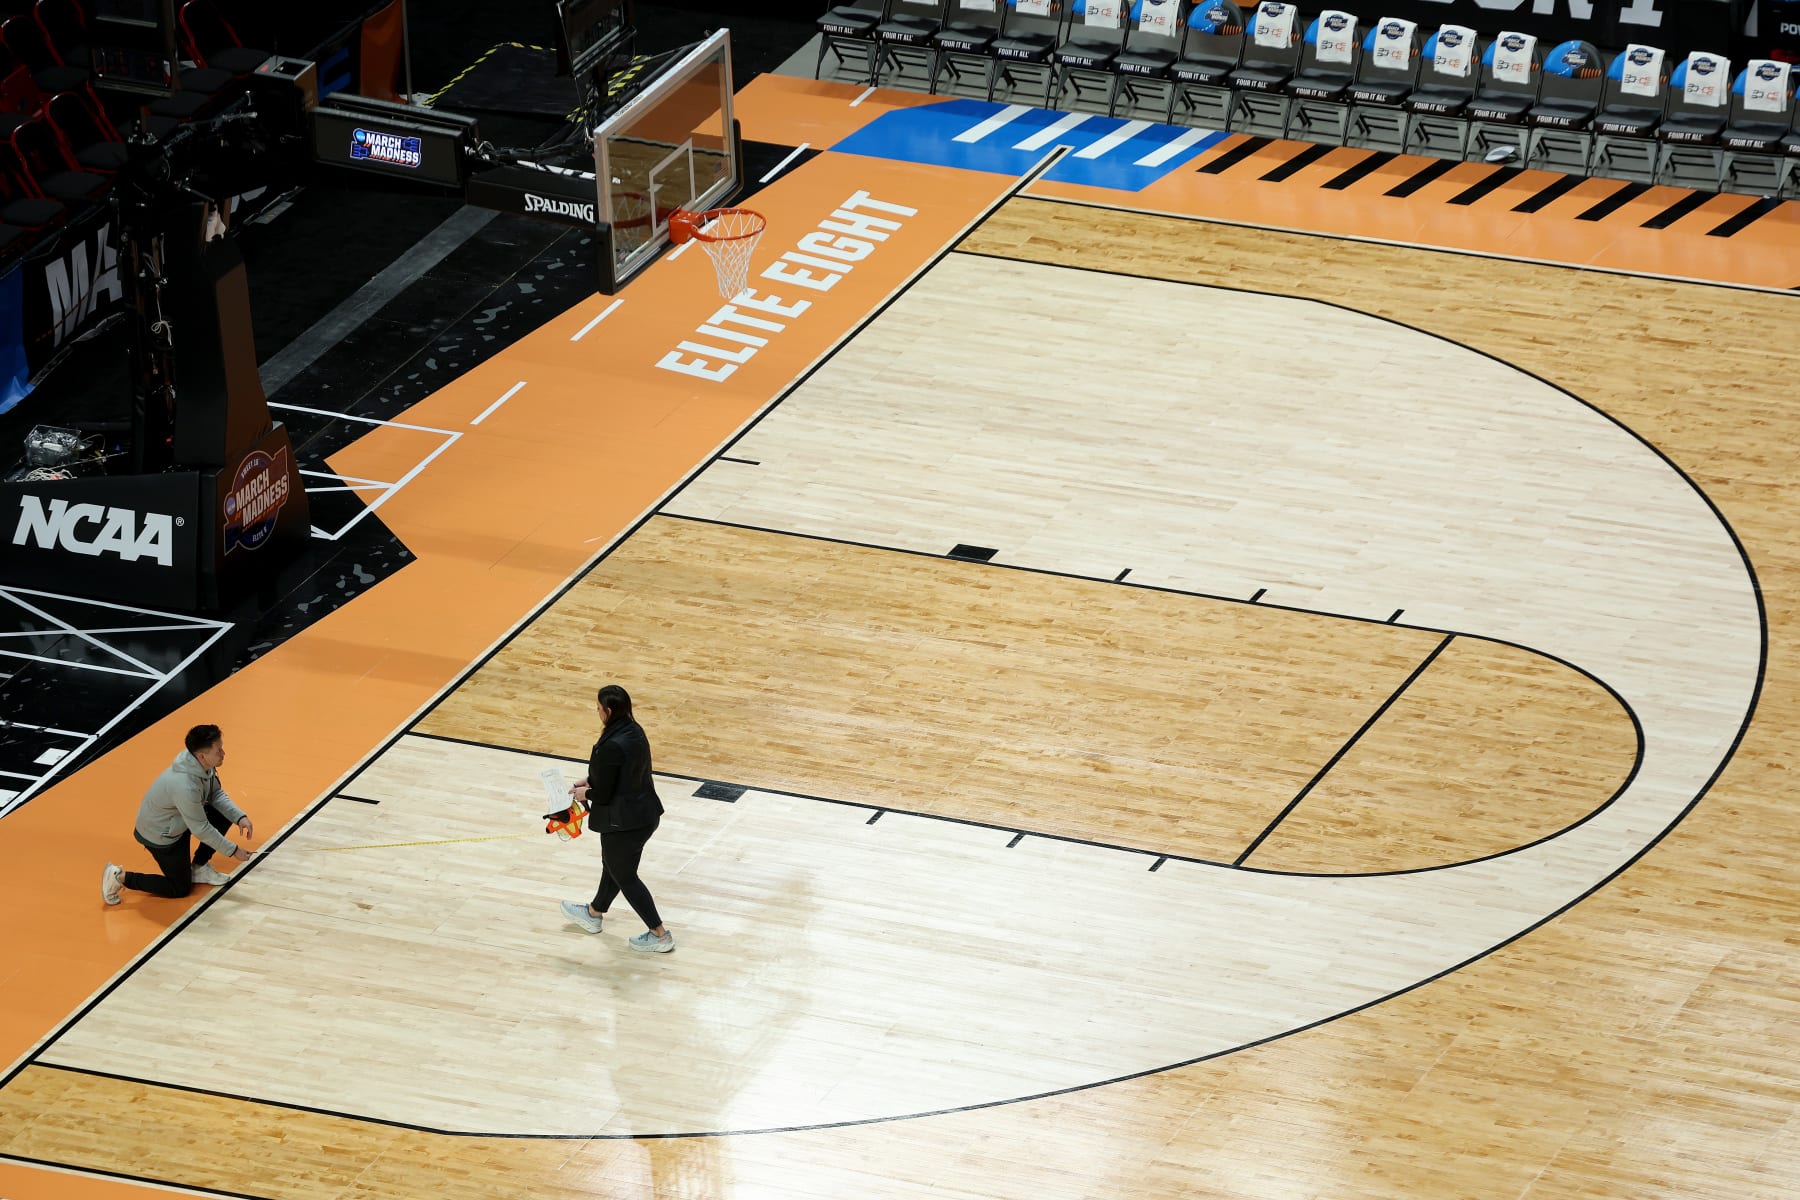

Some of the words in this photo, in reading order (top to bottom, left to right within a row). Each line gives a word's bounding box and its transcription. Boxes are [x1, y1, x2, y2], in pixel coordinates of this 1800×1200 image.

[1780, 22, 1800, 36] PO
[366, 133, 402, 149] MARCH
[371, 144, 419, 163] MADNESS
[524, 193, 594, 224] SPALDING
[654, 287, 812, 383] ELITE
[760, 189, 918, 292] EIGHT
[235, 467, 270, 512] MARCH
[242, 474, 288, 527] MADNESS
[12, 494, 173, 567] NCAA
